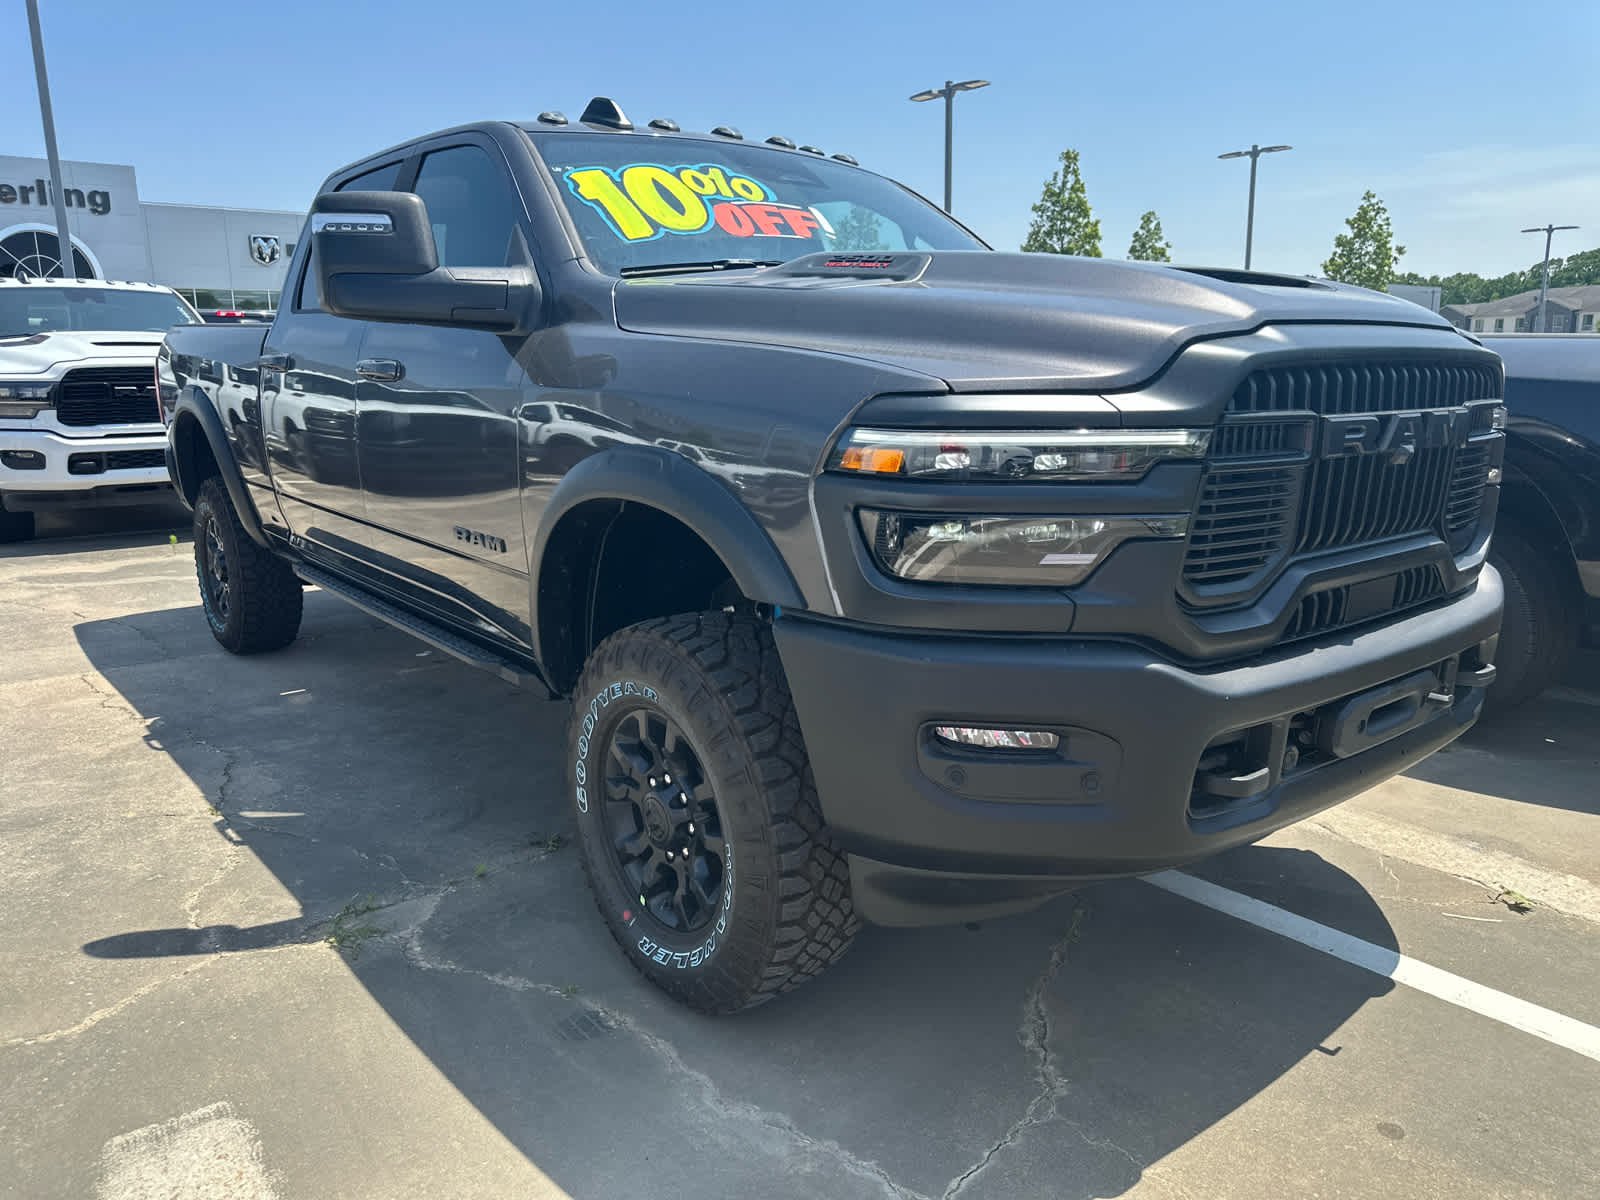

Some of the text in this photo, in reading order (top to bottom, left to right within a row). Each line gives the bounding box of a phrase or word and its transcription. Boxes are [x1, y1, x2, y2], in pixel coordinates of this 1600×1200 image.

[0, 178, 112, 216] erlng
[567, 165, 767, 241] 10%
[1322, 408, 1469, 458] RAM
[452, 524, 507, 553] RAM
[576, 681, 659, 814] GOODYEAR
